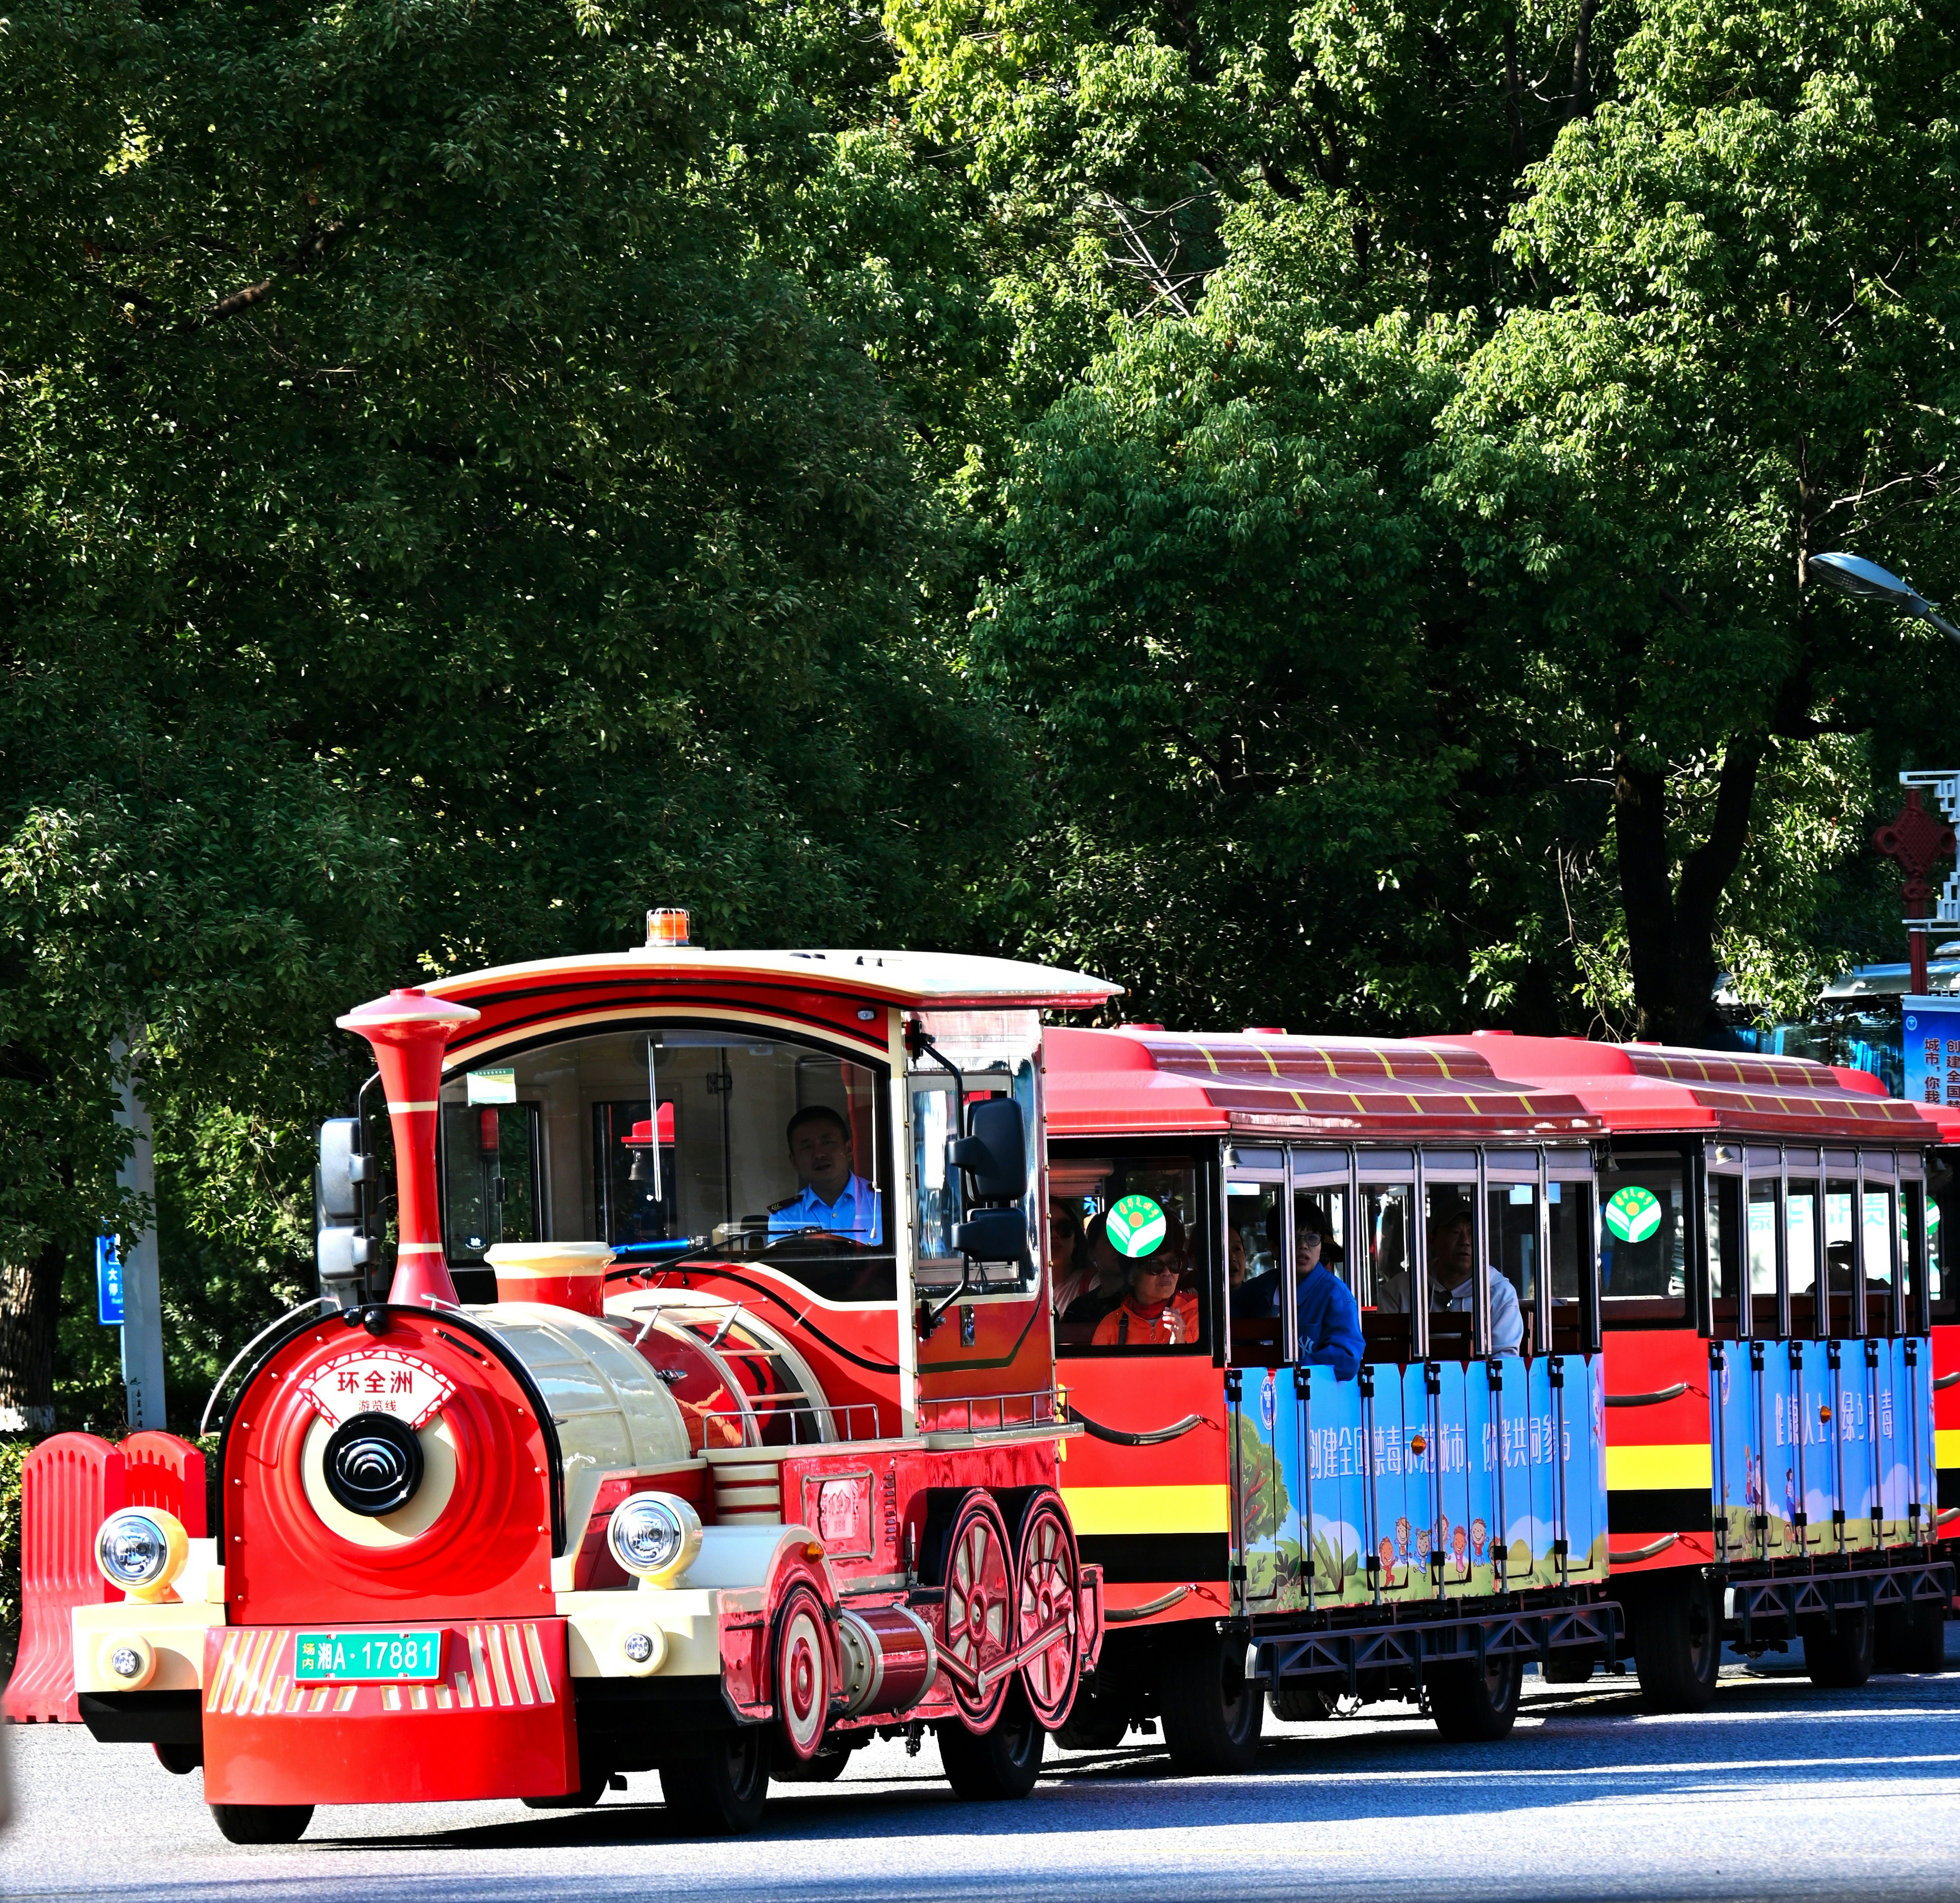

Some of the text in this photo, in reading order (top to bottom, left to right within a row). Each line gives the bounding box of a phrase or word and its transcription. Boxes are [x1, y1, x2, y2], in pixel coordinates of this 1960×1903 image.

[337, 1370, 412, 1393] 环全洲
[359, 1399, 397, 1411] 游览线
[302, 1643, 315, 1670] 场内
